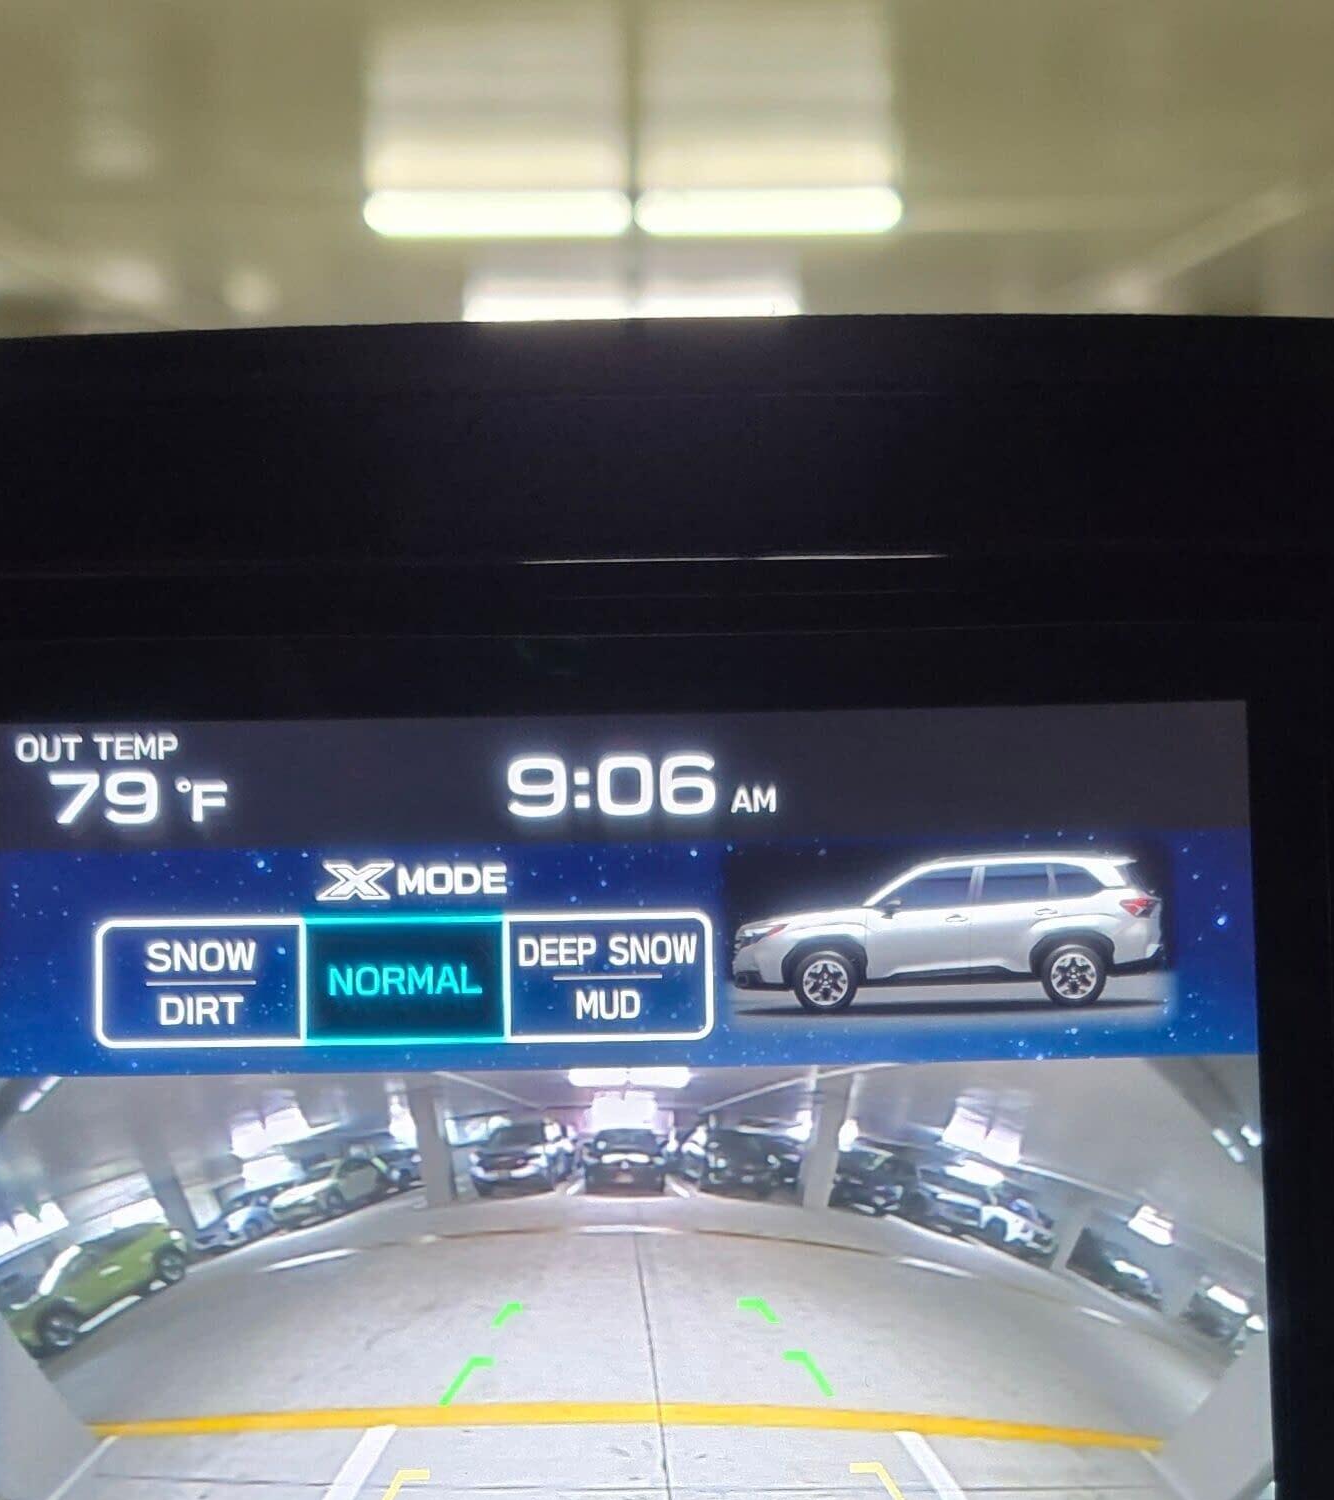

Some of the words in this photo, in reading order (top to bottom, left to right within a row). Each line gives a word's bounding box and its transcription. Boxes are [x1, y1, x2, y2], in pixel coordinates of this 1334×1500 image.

[15, 735, 82, 764] OUT
[93, 734, 178, 762] TEMP
[48, 772, 157, 825] 79
[507, 754, 715, 817] 9:06
[731, 786, 777, 814] AM
[397, 864, 507, 896] MODE
[145, 941, 256, 973] SNOW
[518, 938, 597, 968] DEEP
[609, 935, 697, 966] SNOW
[329, 965, 482, 996] NORMAL
[159, 993, 244, 1026] DIRT
[575, 990, 641, 1020] MUD
